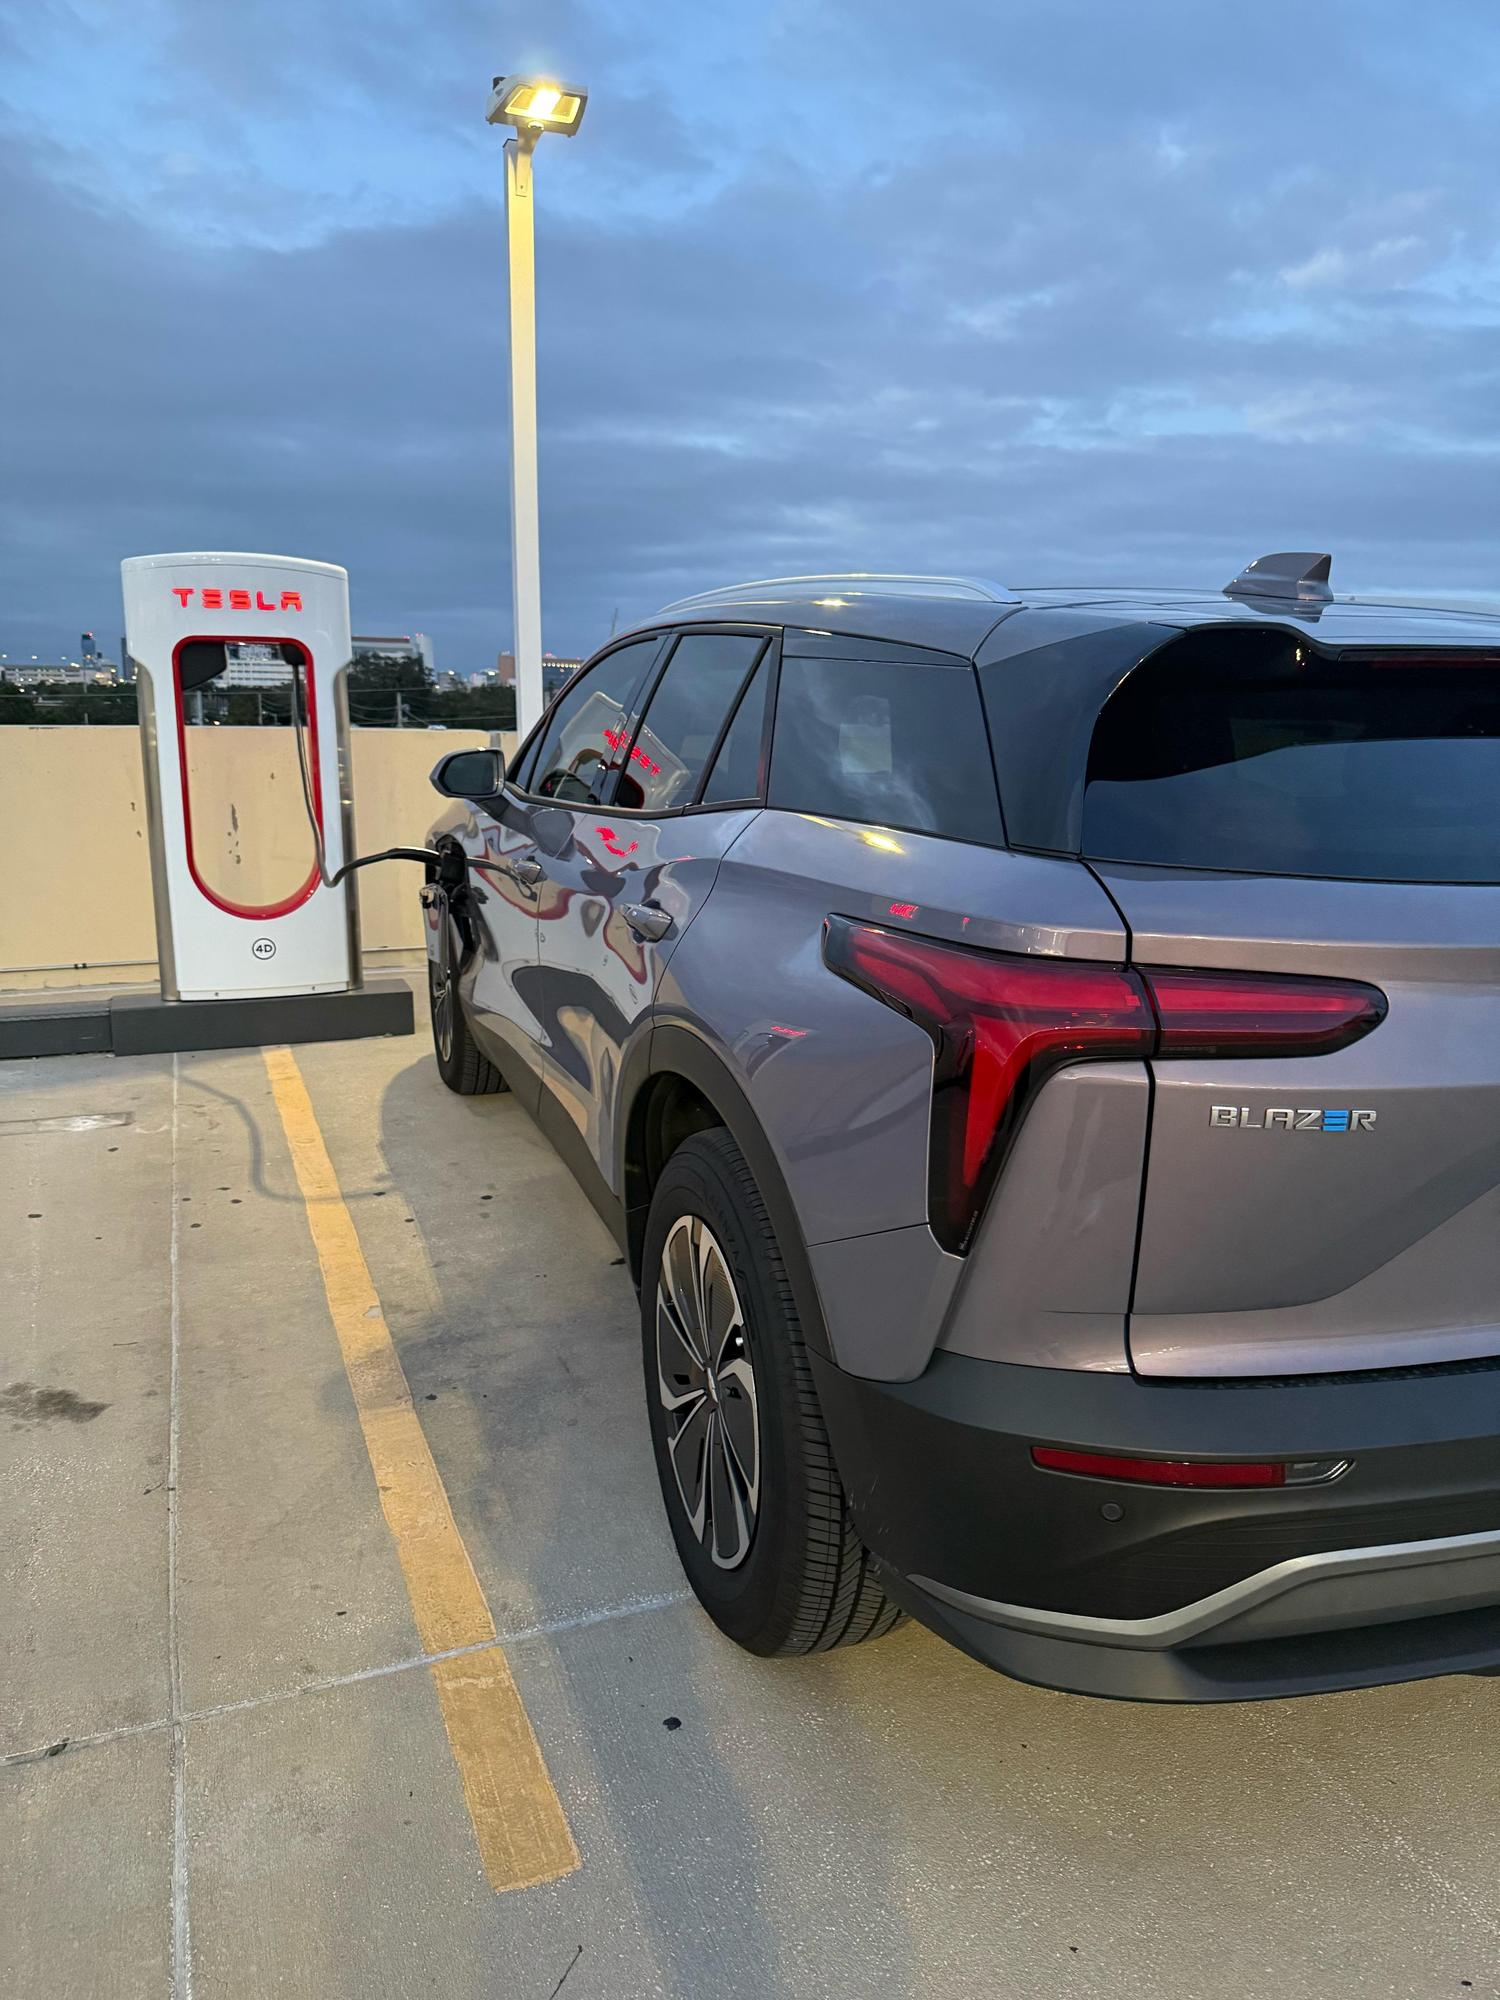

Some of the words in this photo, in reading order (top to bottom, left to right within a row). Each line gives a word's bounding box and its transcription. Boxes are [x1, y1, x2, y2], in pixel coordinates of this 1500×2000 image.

[171, 588, 303, 611] TESLA
[255, 944, 273, 953] 4D
[1209, 1105, 1377, 1132] BLAZER
